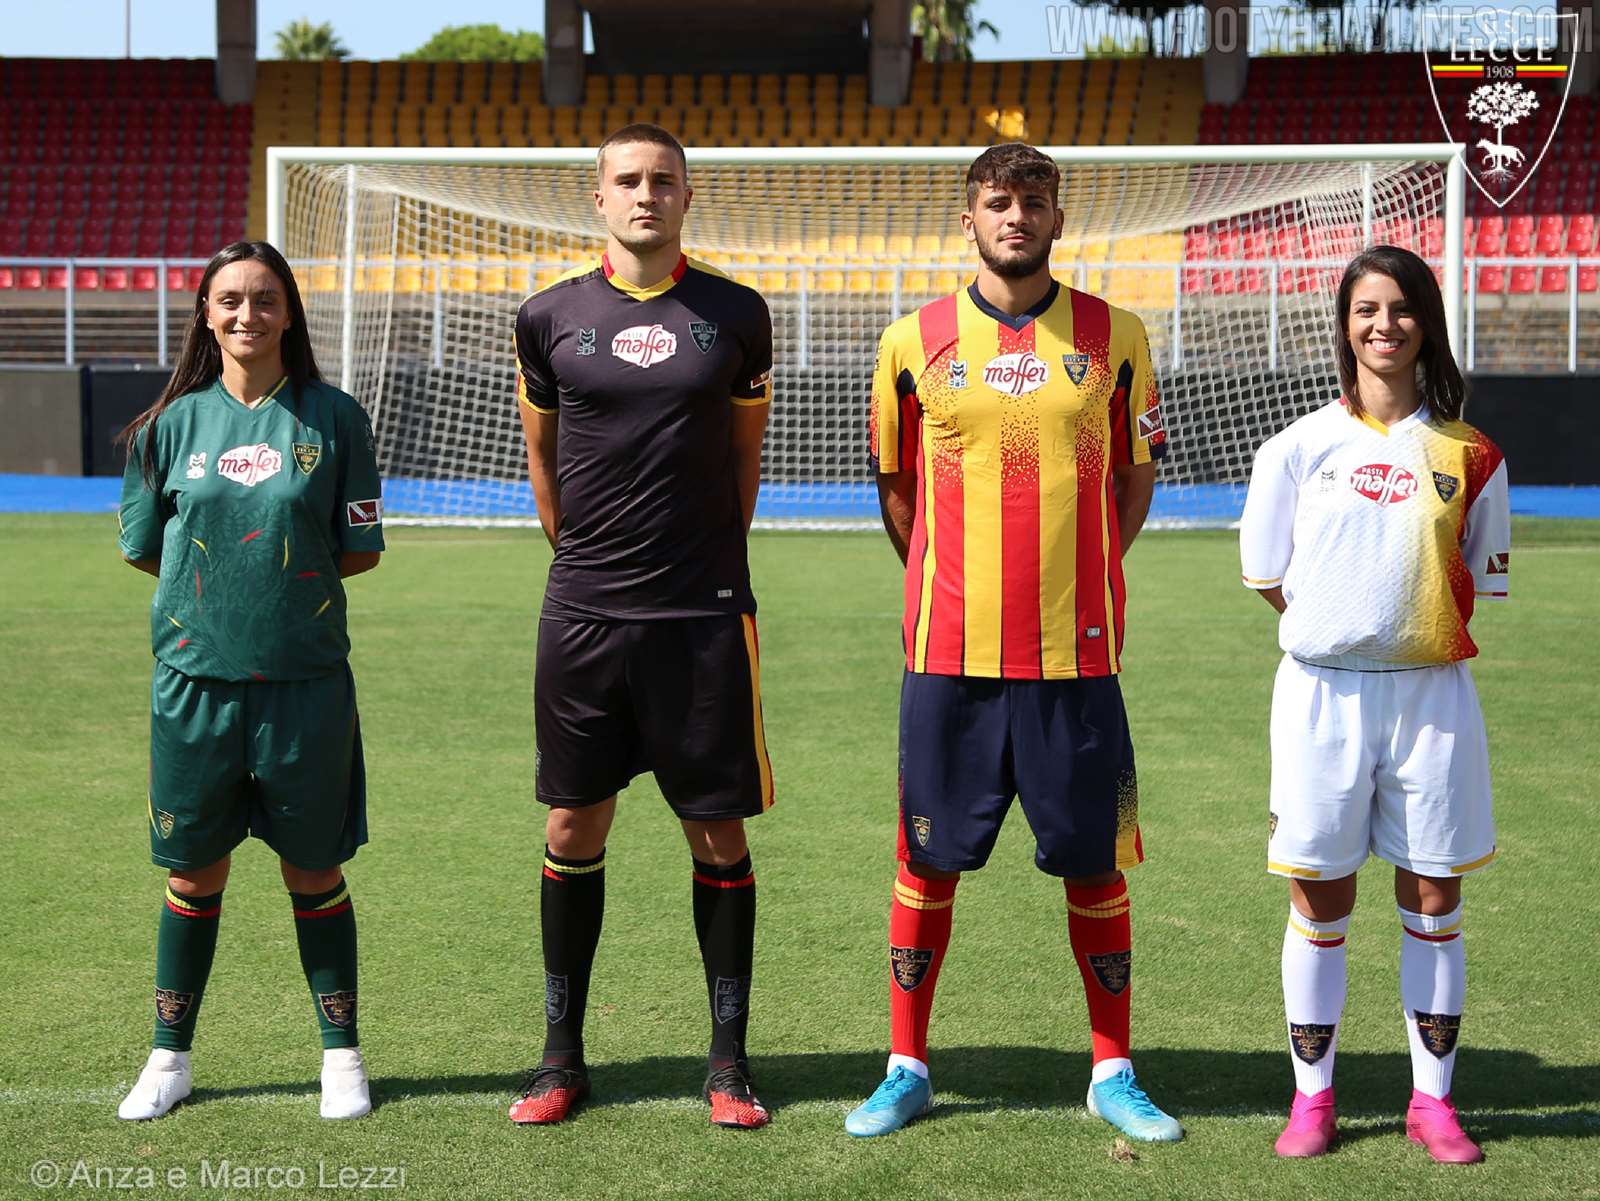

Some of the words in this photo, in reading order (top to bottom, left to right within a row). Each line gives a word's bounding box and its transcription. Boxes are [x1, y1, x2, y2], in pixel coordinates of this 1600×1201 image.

[614, 325, 675, 365] maffei
[984, 352, 1047, 396] maffei
[220, 444, 281, 486] maffei
[1360, 467, 1385, 476] PASTA
